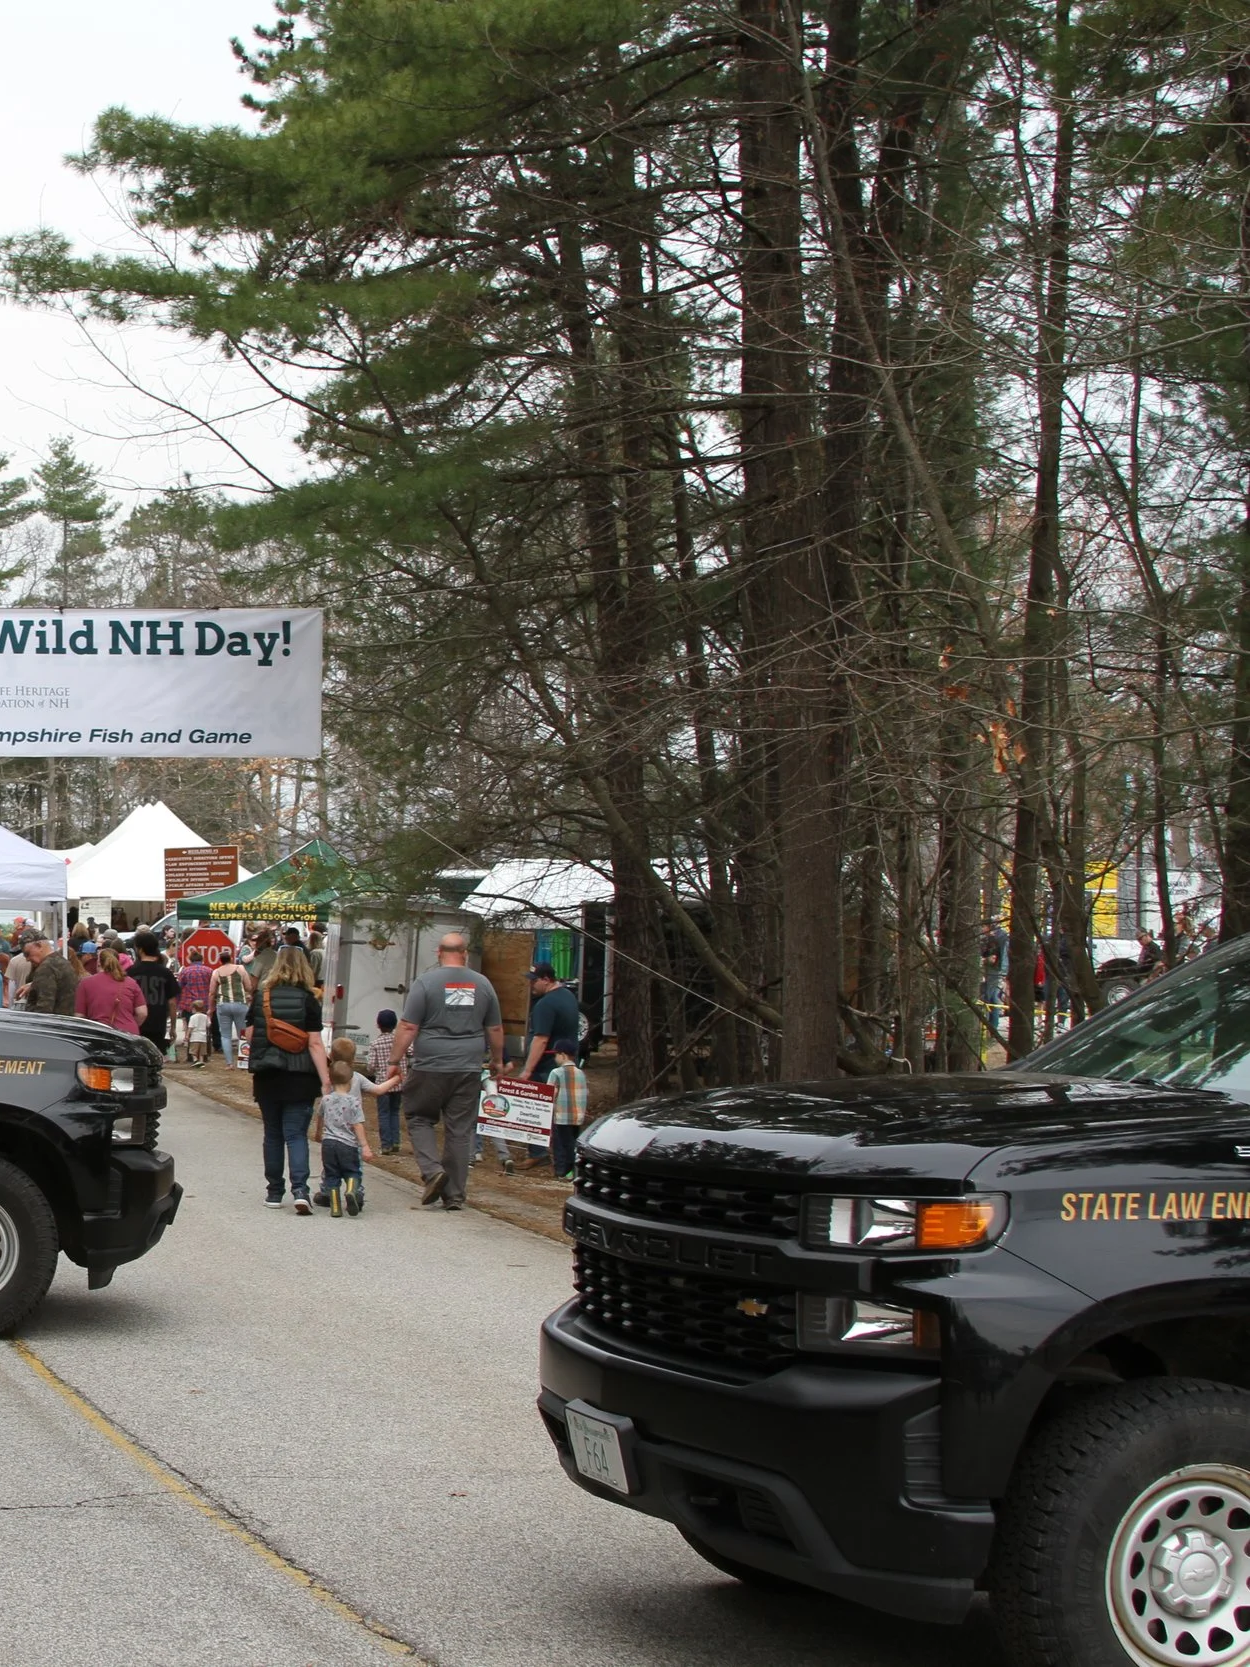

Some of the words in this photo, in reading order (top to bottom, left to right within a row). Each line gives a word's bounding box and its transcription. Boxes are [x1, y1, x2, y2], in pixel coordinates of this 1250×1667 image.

[109, 621, 184, 656] NH
[195, 621, 292, 666] Day!
[50, 699, 69, 708] NH
[89, 728, 133, 743] Fish
[140, 729, 182, 744] and
[188, 729, 252, 744] Game
[209, 902, 237, 911] NEW
[187, 945, 232, 965] STOP
[511, 1081, 538, 1091] Hampshire
[520, 1090, 539, 1098] Garden
[539, 1092, 553, 1101] Expo
[520, 1111, 540, 1119] Deerfield
[516, 1117, 542, 1126] Fairgrounds
[1060, 1192, 1141, 1221] STATE
[1147, 1192, 1206, 1220] LAW
